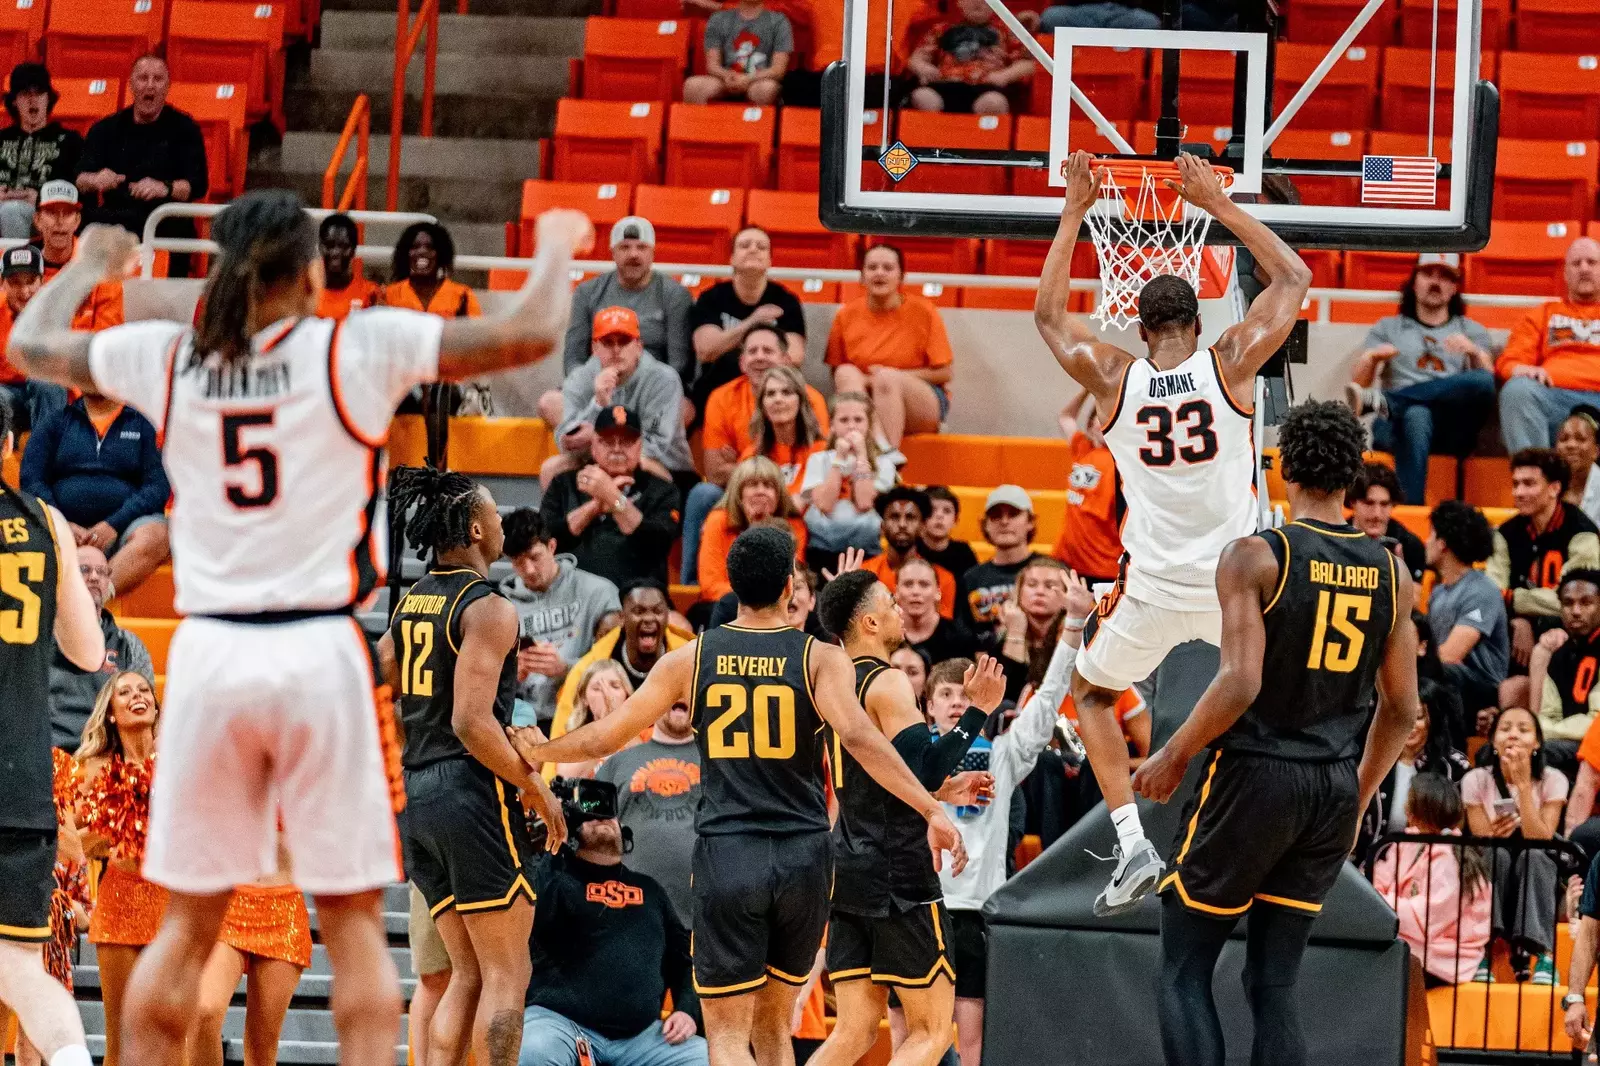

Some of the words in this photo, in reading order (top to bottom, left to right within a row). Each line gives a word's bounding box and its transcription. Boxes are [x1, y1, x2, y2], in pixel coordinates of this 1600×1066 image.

[887, 156, 910, 166] NIT
[220, 406, 280, 511] 5
[1136, 399, 1219, 468] 33
[1310, 559, 1379, 590] BALLARD
[401, 620, 434, 697] 12
[716, 654, 788, 677] BEVERLY
[1307, 590, 1373, 673] 15
[706, 683, 796, 760] 20
